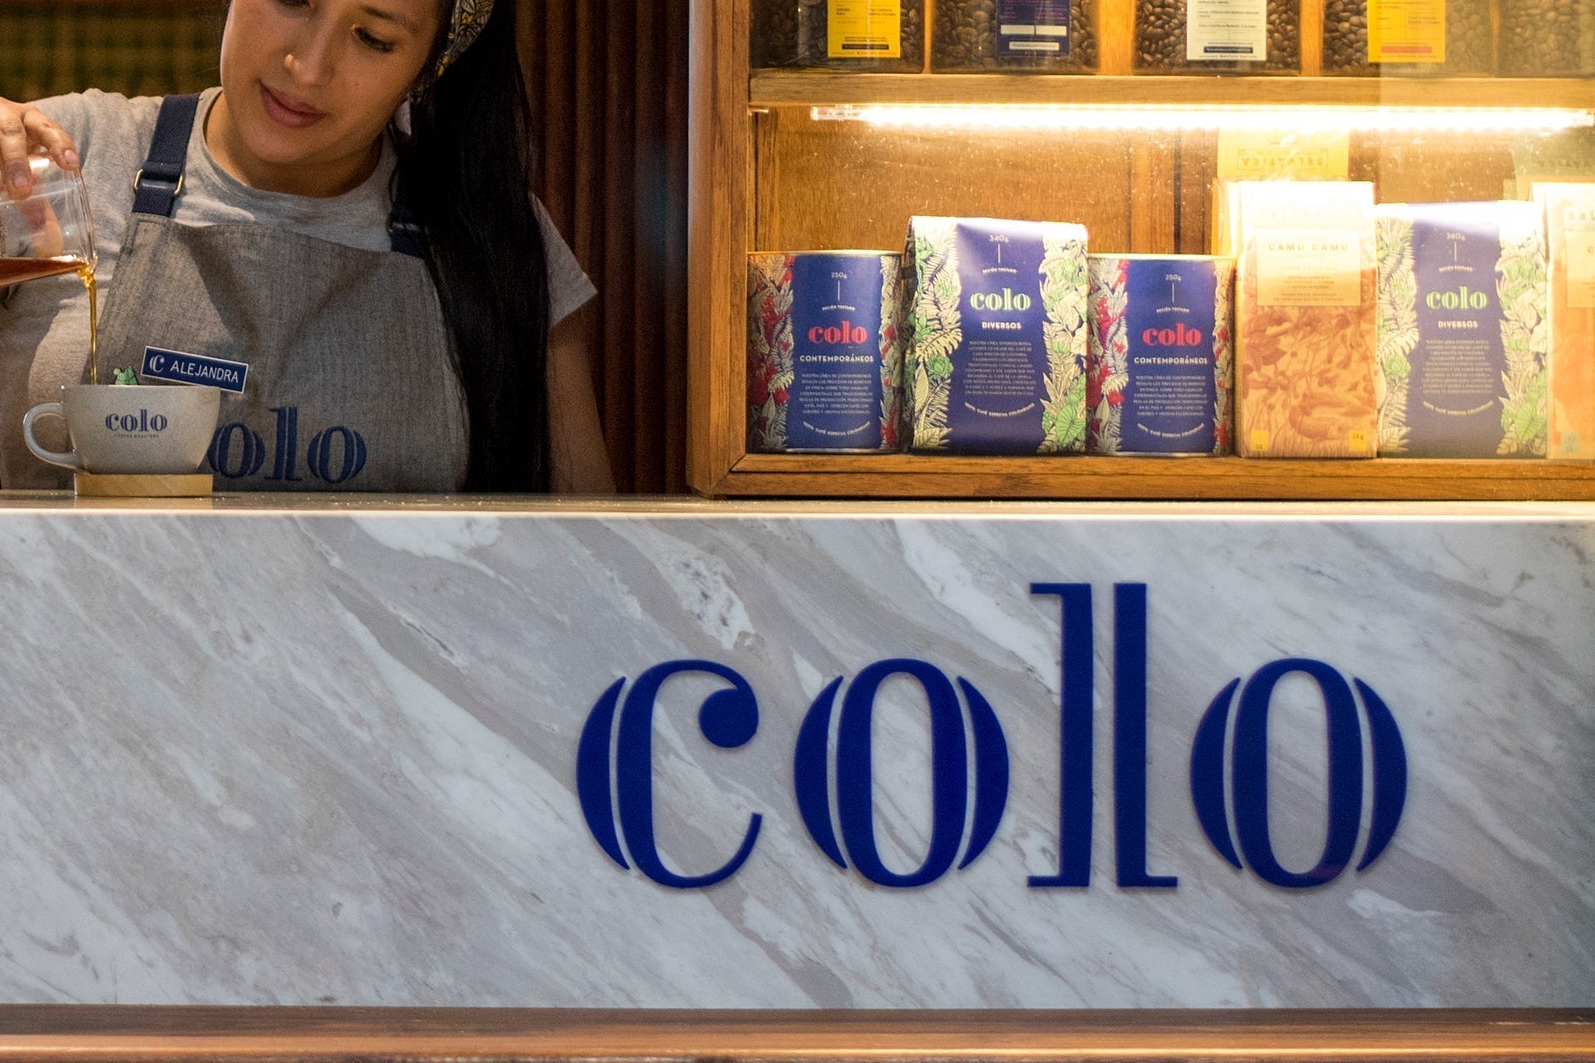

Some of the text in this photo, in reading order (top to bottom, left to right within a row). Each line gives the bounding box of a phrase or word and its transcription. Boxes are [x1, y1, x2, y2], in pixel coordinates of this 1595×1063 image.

[1268, 243, 1348, 252] CAMU CAMU
[970, 288, 1031, 311] colo
[1426, 285, 1488, 310] colo
[808, 320, 868, 345] colo
[982, 322, 1022, 330] DIVERSOS
[1142, 322, 1203, 346] colo
[1438, 320, 1479, 329] DIVERSOS
[799, 353, 875, 363] CONTEMPORÁNEOS
[1133, 355, 1208, 365] CONTEMPORÁNEOS
[170, 360, 239, 383] ALEJANDRA
[105, 409, 168, 432] colo
[207, 407, 367, 483] olo
[576, 582, 1407, 888] colo
